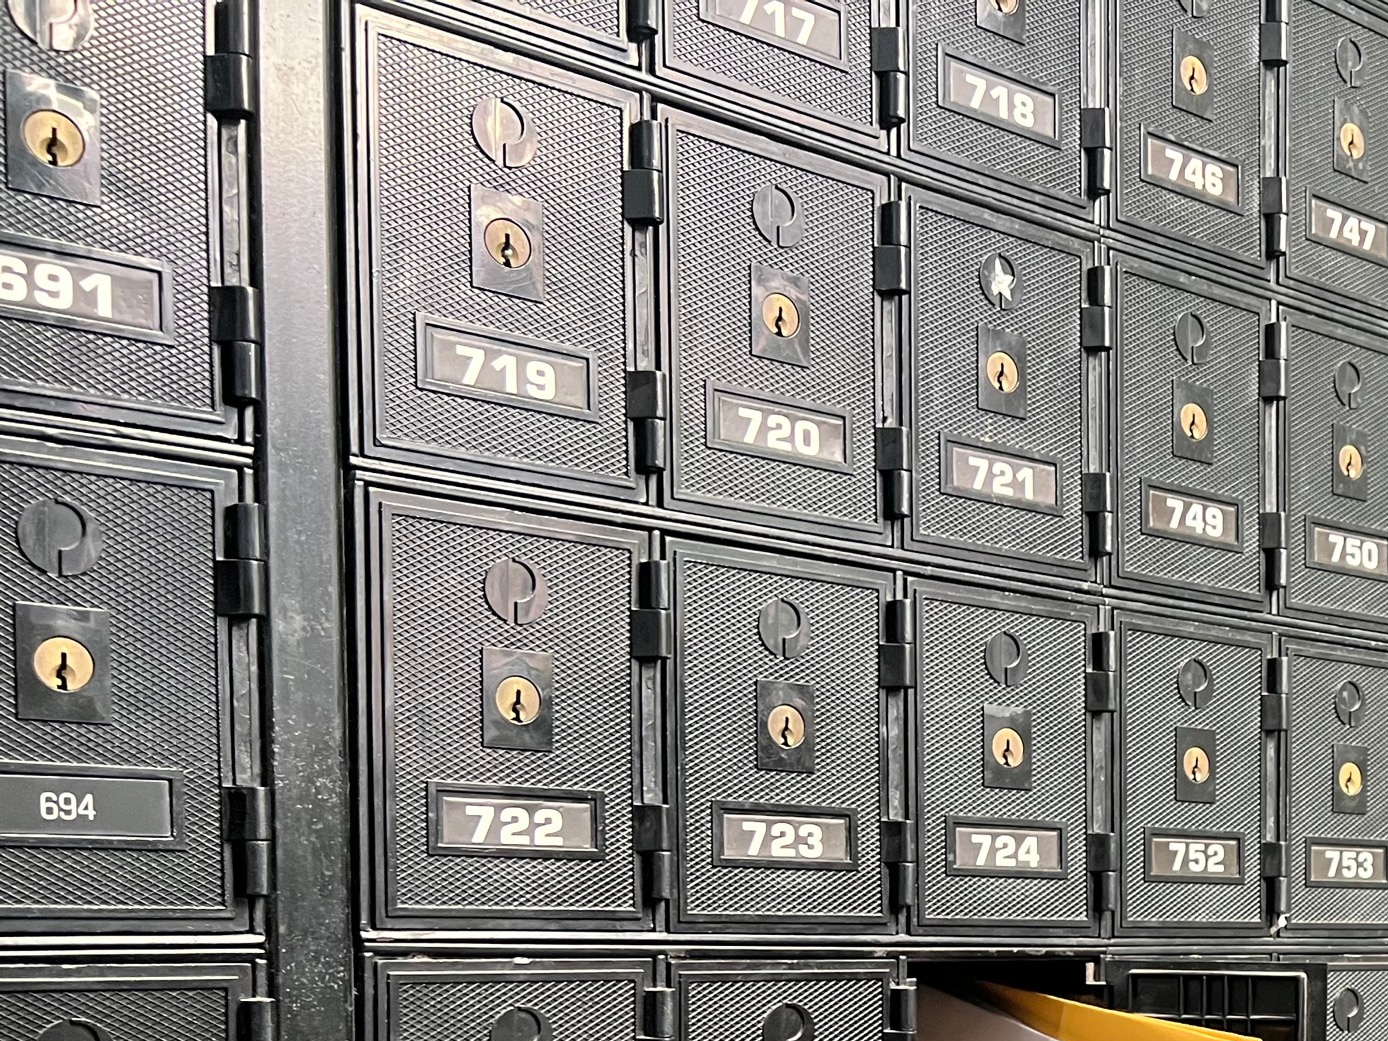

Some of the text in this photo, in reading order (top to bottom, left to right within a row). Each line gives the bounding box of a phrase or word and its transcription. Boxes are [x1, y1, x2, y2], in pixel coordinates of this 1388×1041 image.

[965, 73, 1035, 128] 718
[1165, 148, 1223, 196] 746
[1326, 208, 1376, 251] 747
[0, 257, 113, 318] 691
[455, 344, 556, 401] 719
[738, 406, 820, 456] 720
[968, 456, 1034, 500] 721
[1166, 497, 1223, 538] 749
[1328, 534, 1379, 570] 750
[40, 792, 96, 820] 694
[466, 805, 563, 845] 722
[742, 821, 823, 858] 723
[972, 834, 1039, 867] 724
[1169, 842, 1225, 873] 752
[1325, 850, 1374, 879] 753
